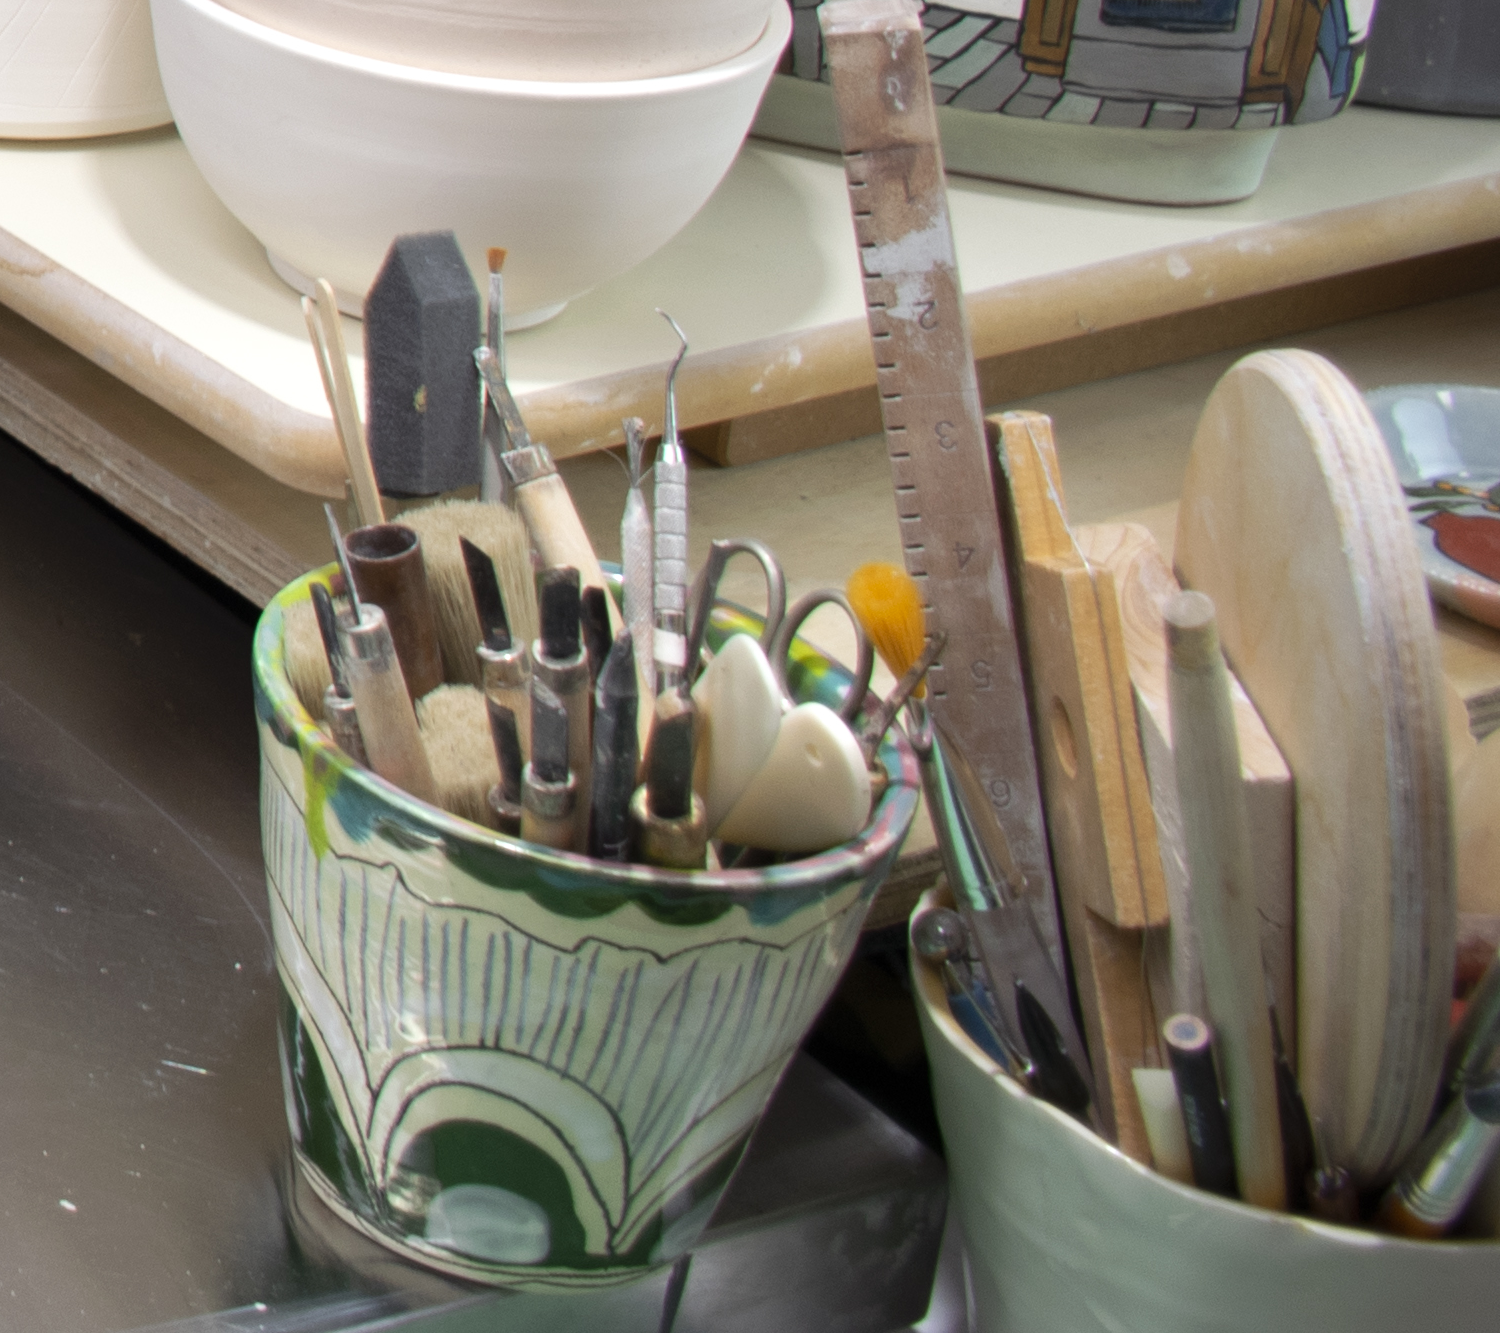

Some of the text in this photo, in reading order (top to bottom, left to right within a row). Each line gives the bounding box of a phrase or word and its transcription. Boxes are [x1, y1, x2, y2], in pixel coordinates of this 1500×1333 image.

[913, 300, 937, 331] 2
[935, 420, 957, 450] 3
[953, 541, 975, 571] 4
[971, 659, 992, 691] 5
[991, 779, 1011, 808] 6
